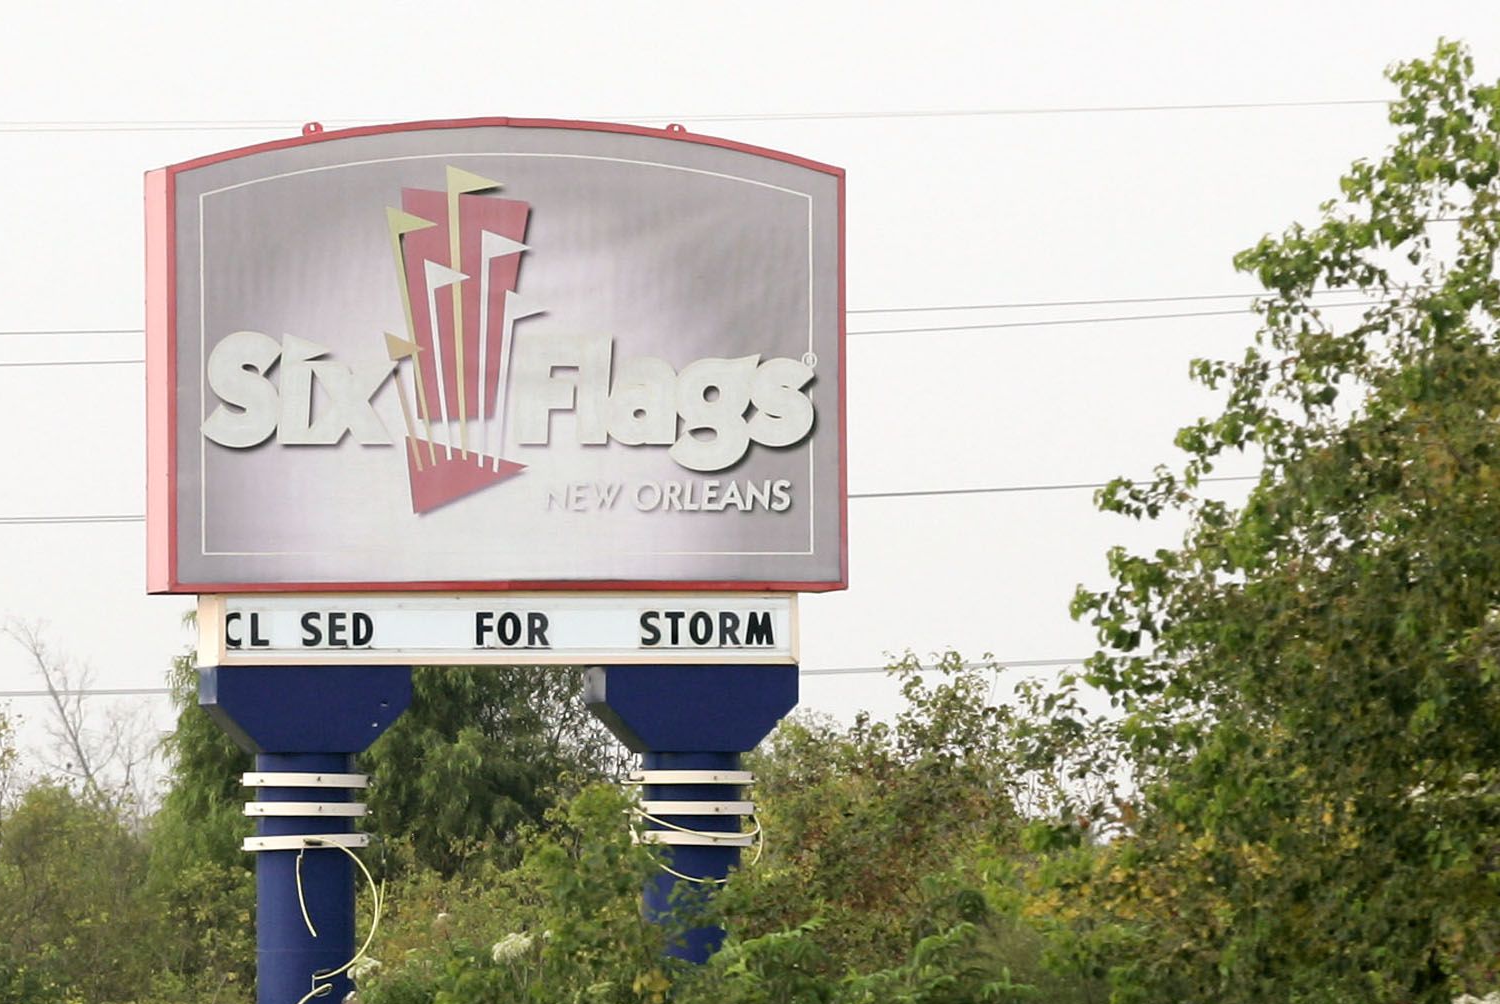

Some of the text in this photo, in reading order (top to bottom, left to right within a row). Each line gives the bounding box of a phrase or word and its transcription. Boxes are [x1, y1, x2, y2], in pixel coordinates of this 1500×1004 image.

[200, 331, 815, 471] Six Flags
[546, 480, 791, 511] NEW ORLEANS
[476, 612, 549, 646] FOR
[640, 611, 775, 646] STORM
